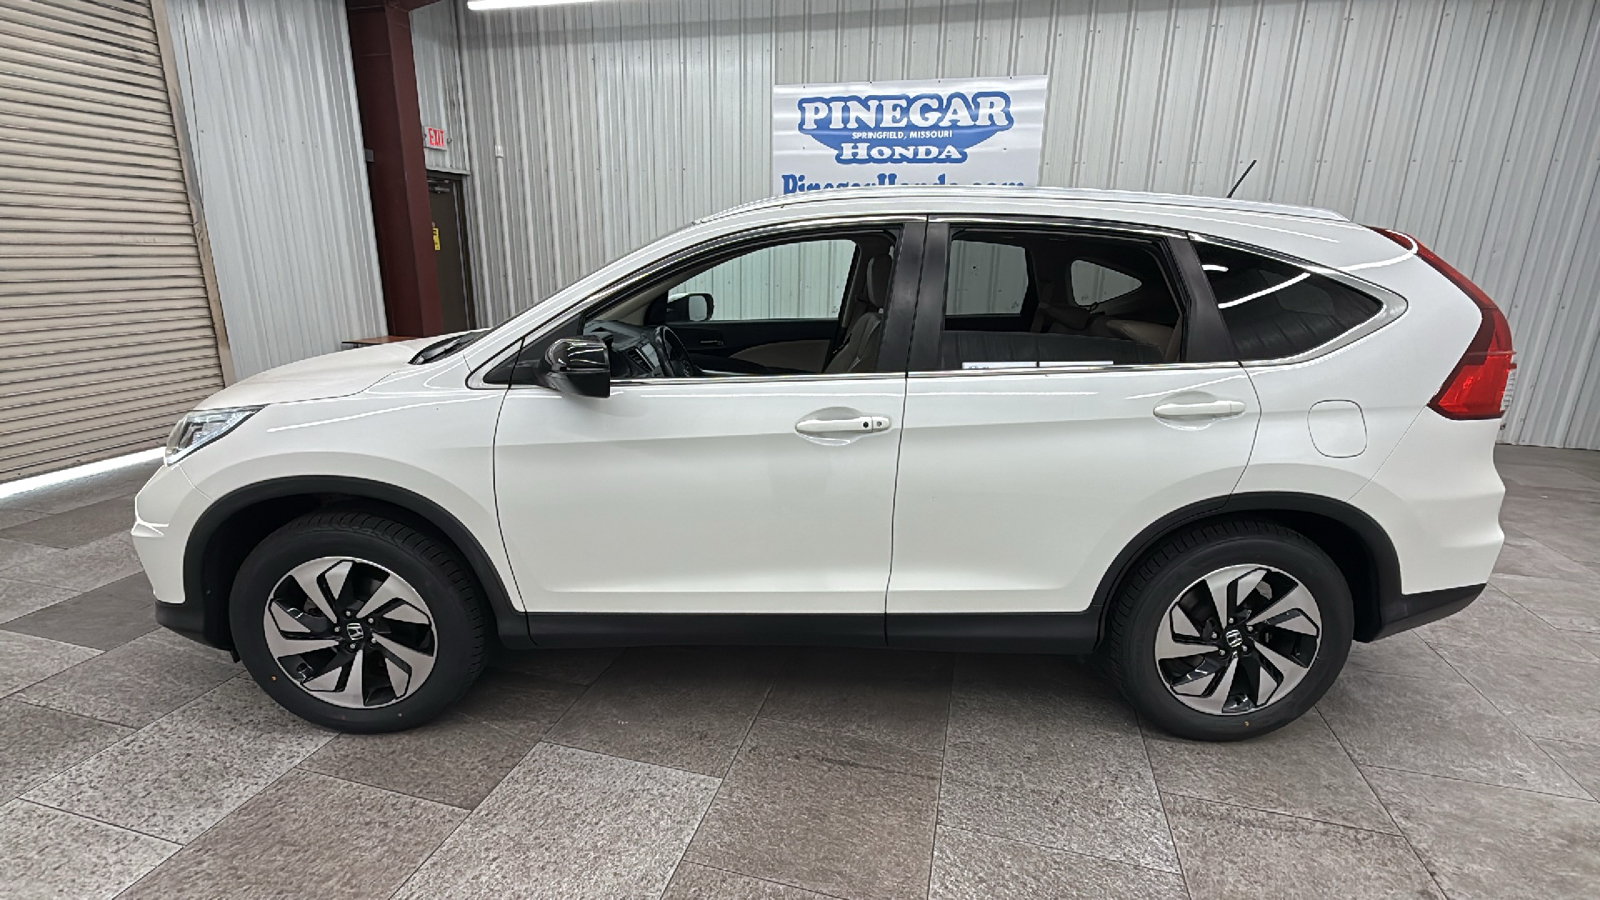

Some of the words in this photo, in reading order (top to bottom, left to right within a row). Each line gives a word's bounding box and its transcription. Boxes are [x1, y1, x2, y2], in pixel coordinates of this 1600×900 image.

[802, 96, 1009, 130] PINEGAR
[428, 127, 444, 147] EXIT
[852, 131, 907, 140] SPRINGFIELD,
[909, 130, 953, 139] MISSOURI
